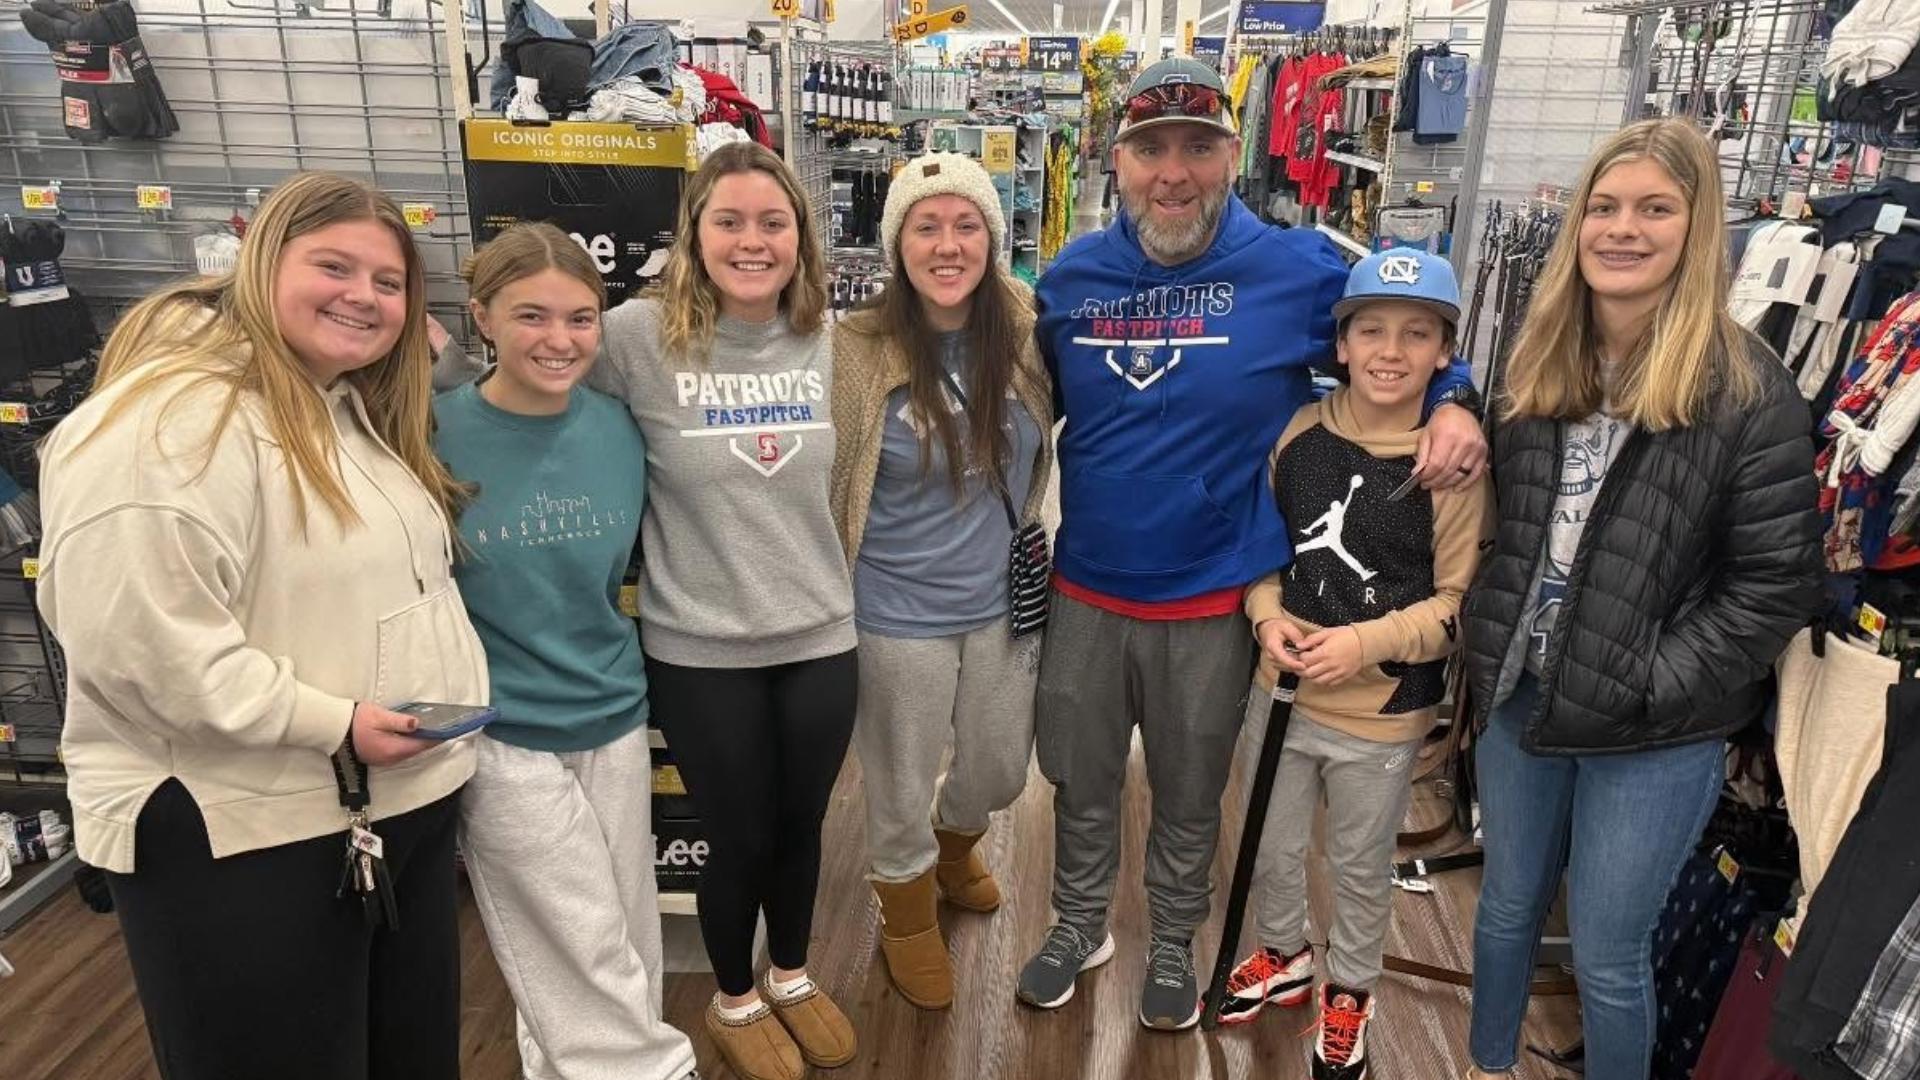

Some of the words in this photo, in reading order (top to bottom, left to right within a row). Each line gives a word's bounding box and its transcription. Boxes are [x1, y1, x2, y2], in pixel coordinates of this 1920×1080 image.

[913, 2, 923, 14] D
[1243, 21, 1262, 30] Low
[1263, 20, 1286, 30] Price
[493, 131, 555, 146] ICONIC
[560, 133, 657, 150] ORIGINALS
[533, 149, 557, 158] STEP
[560, 150, 586, 159] INTO
[587, 151, 619, 160] STYLE
[1092, 318, 1206, 337] FASTPICH
[675, 368, 825, 407] PATRIOTS
[705, 405, 813, 426] FASTPITCH
[757, 433, 781, 463] S
